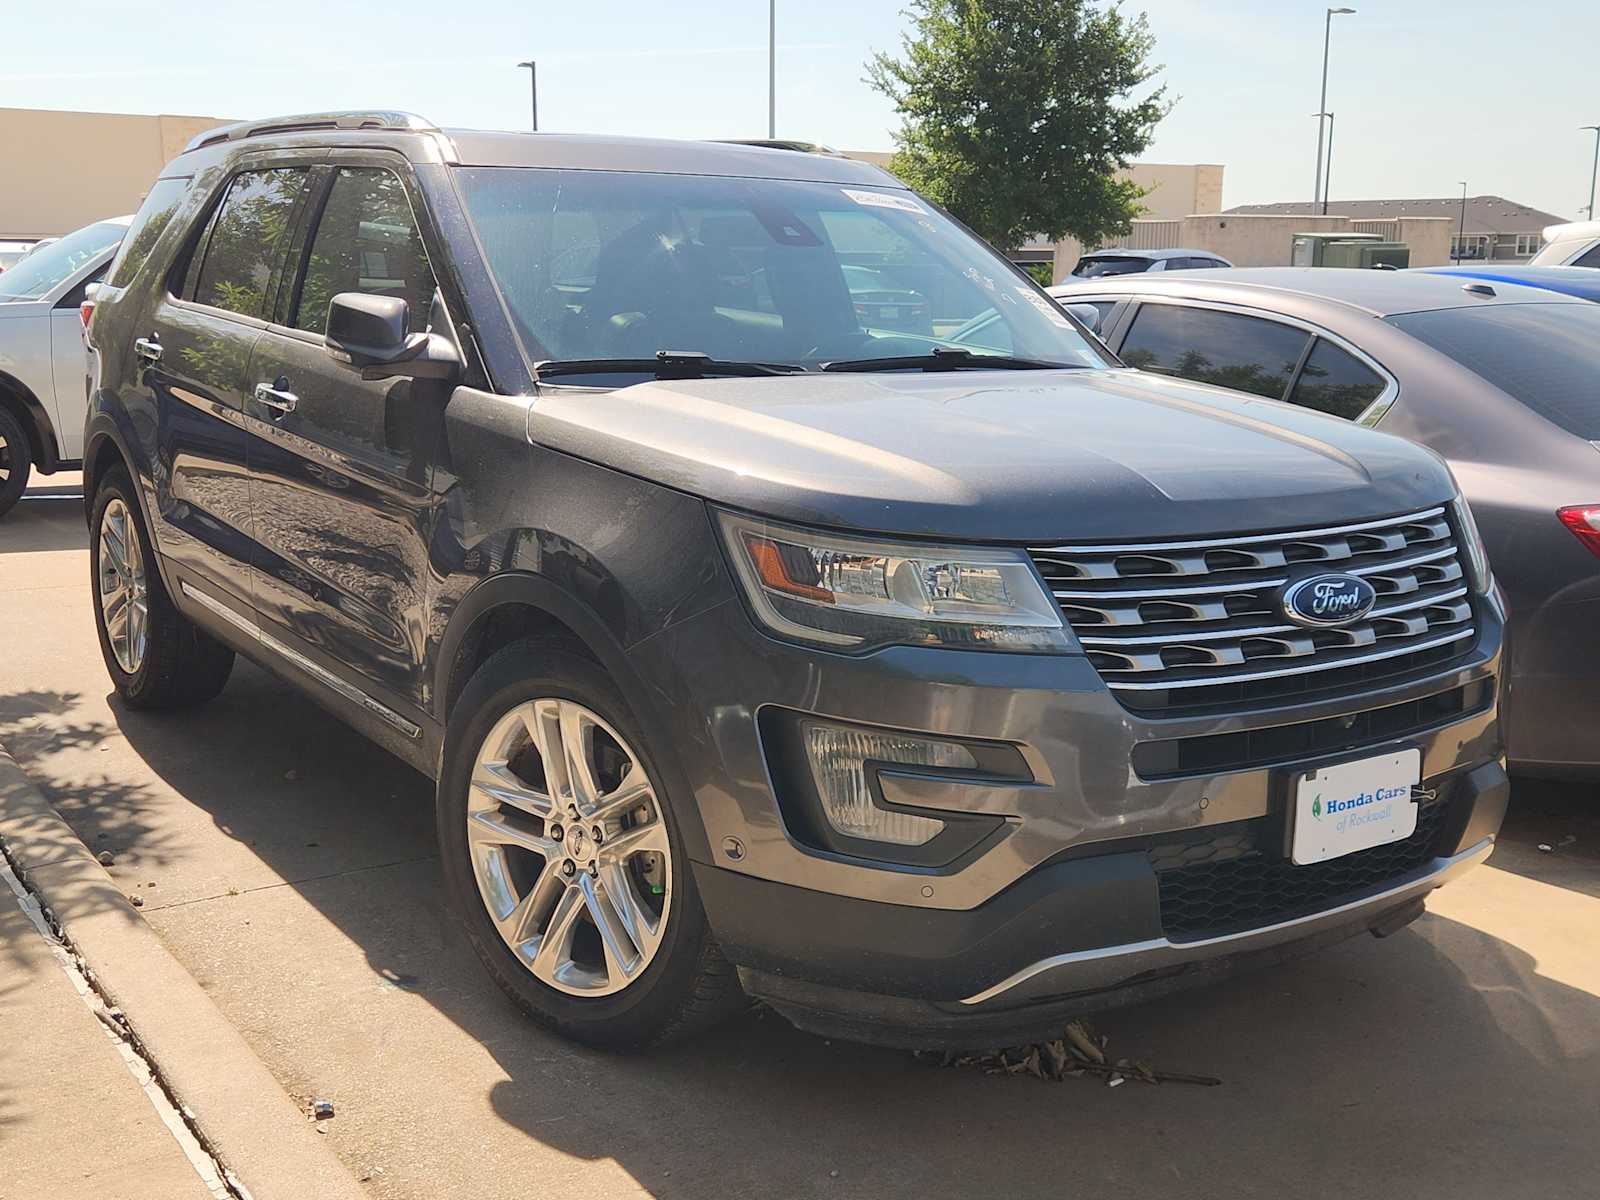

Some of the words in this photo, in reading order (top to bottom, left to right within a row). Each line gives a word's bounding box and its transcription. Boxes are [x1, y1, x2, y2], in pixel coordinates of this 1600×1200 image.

[1313, 582, 1360, 614] Ford
[1326, 793, 1373, 815] Honda
[1375, 785, 1407, 802] Cars
[1336, 815, 1347, 834] of
